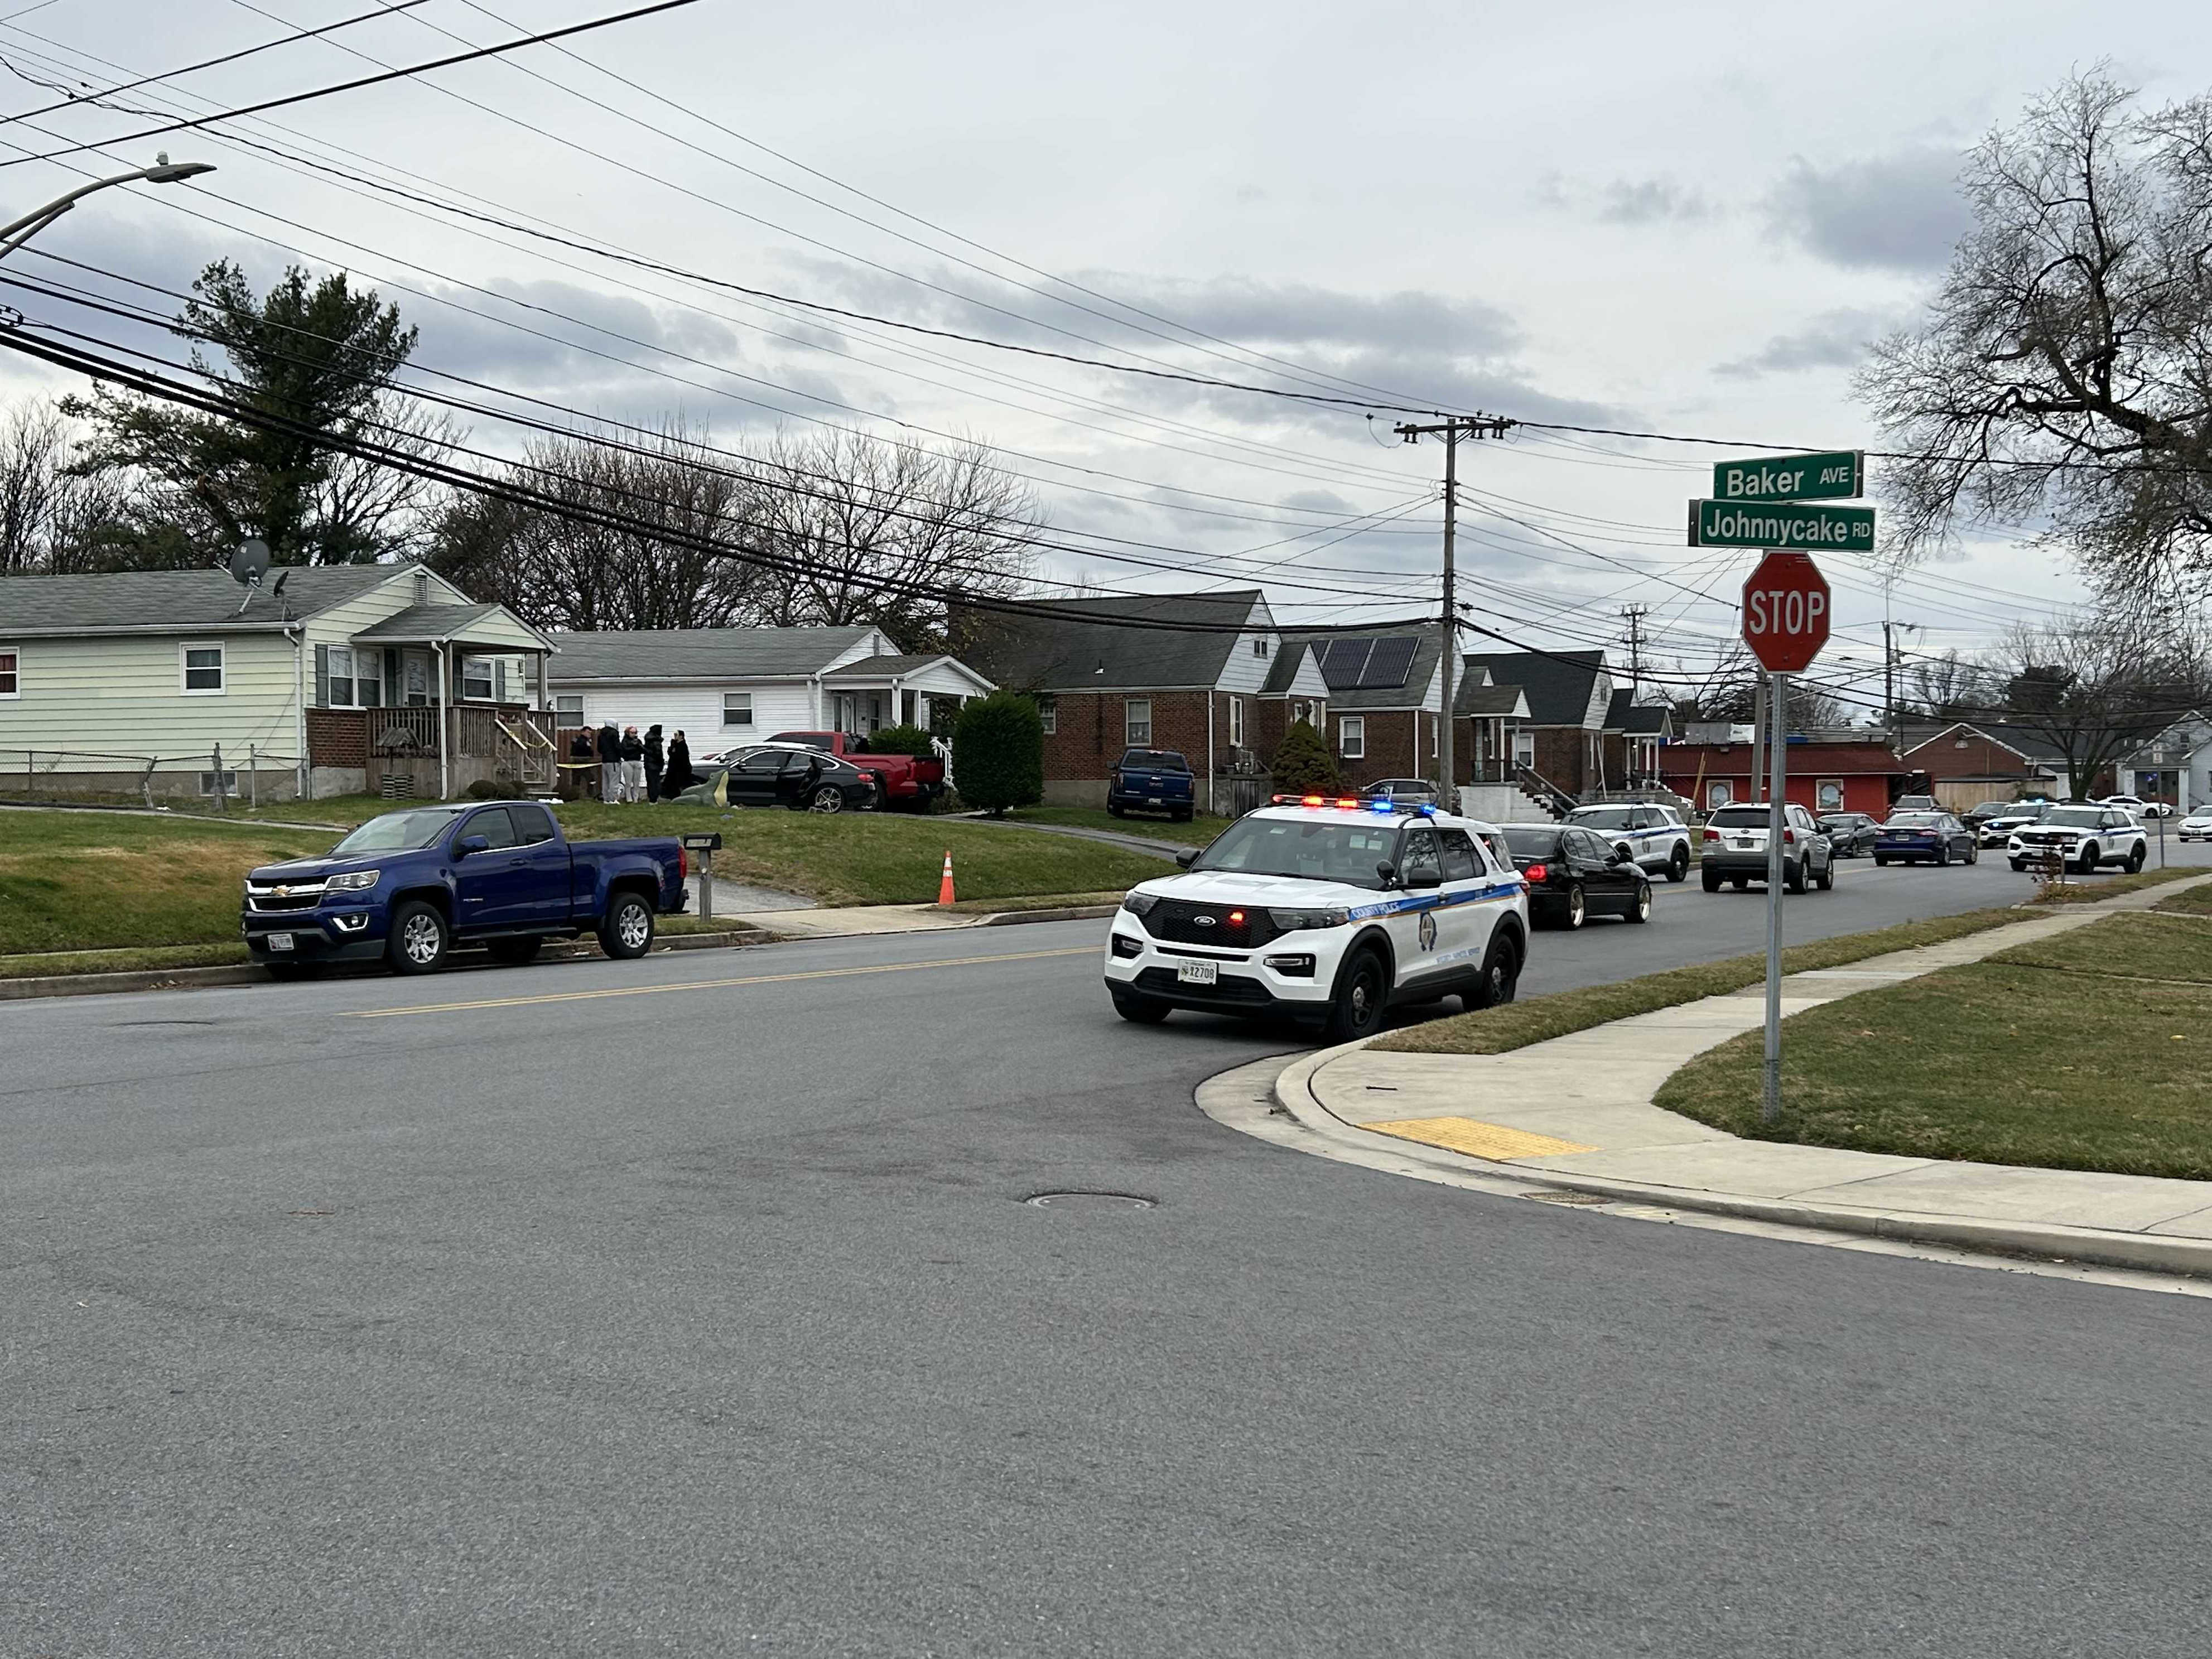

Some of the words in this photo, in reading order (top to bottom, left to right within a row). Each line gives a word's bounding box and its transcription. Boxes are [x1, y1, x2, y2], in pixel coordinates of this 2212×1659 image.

[1727, 467, 1804, 497] Baker
[1819, 466, 1850, 485] AVE
[1706, 509, 1847, 546] Johnnycake
[1852, 523, 1870, 537] RD
[1749, 590, 1824, 635] STOP
